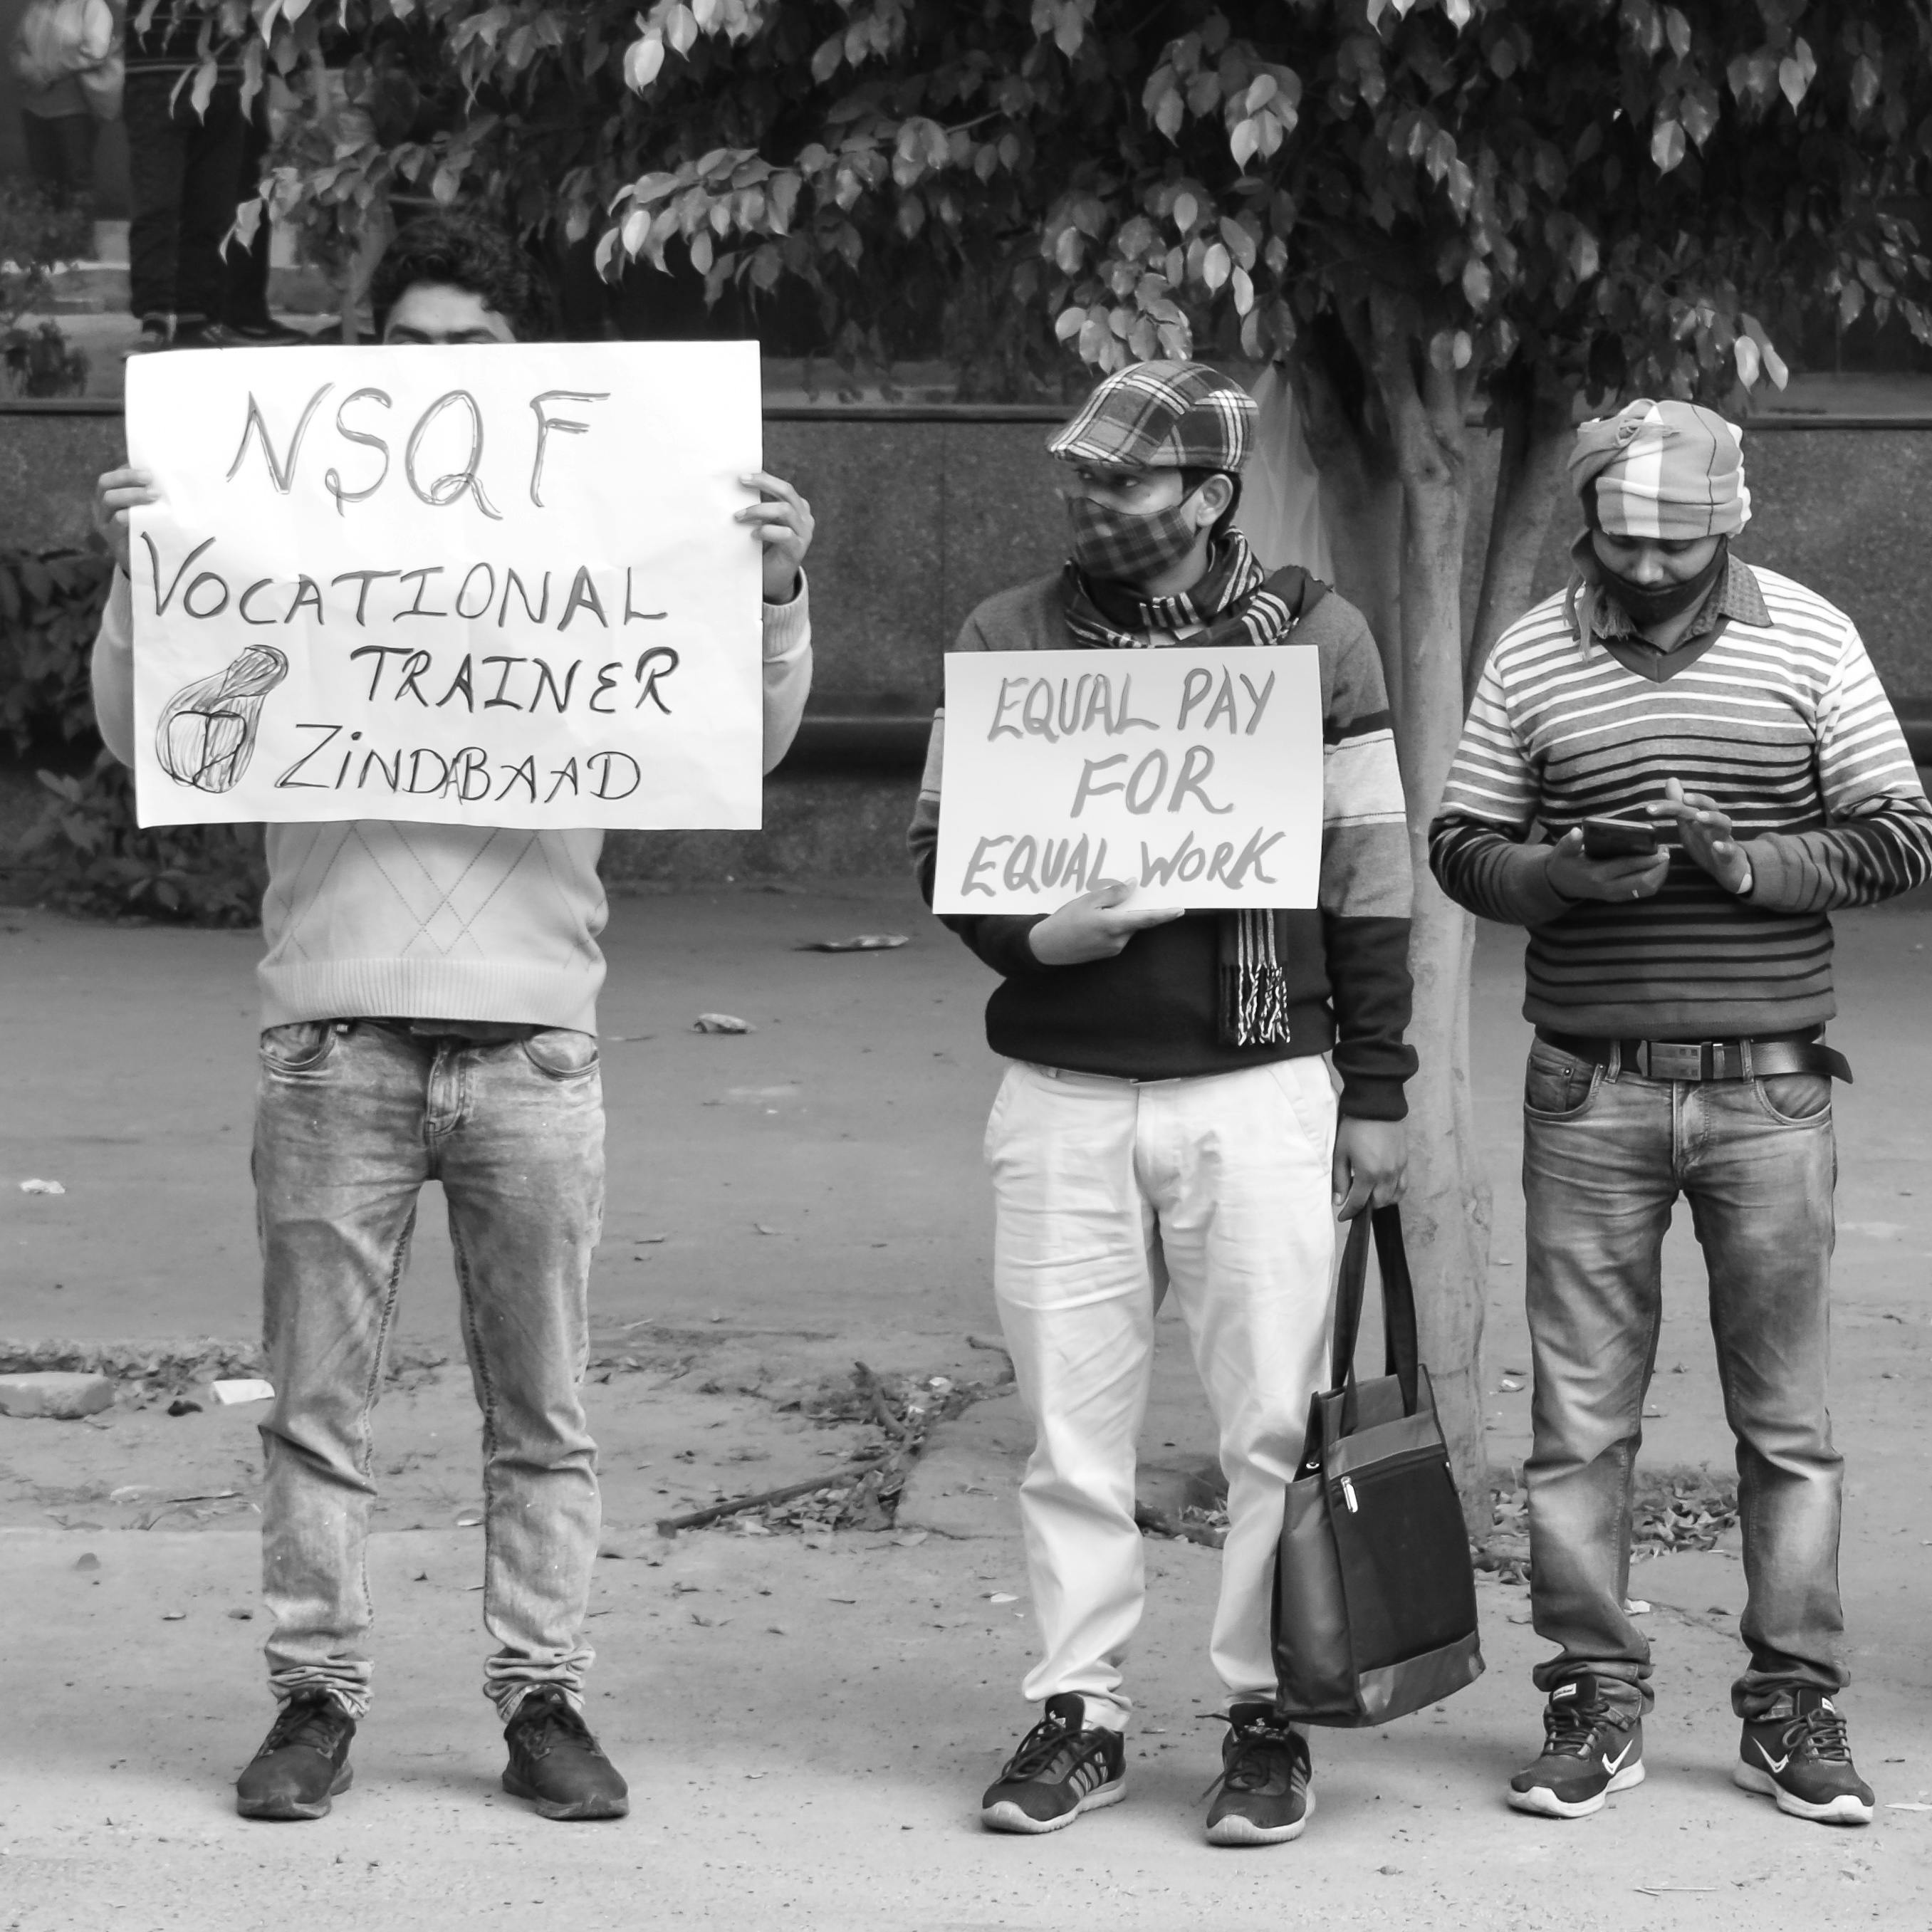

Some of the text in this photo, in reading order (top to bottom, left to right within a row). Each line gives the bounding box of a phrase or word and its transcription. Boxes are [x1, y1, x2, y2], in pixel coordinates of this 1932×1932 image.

[226, 382, 611, 521] NSQF
[140, 530, 668, 632] VOCATIONAL
[348, 645, 680, 716] TRAINER
[987, 663, 1275, 743] EQUAL PAY
[1070, 745, 1234, 818] FOR
[961, 826, 1286, 897] EQUAL WORK
